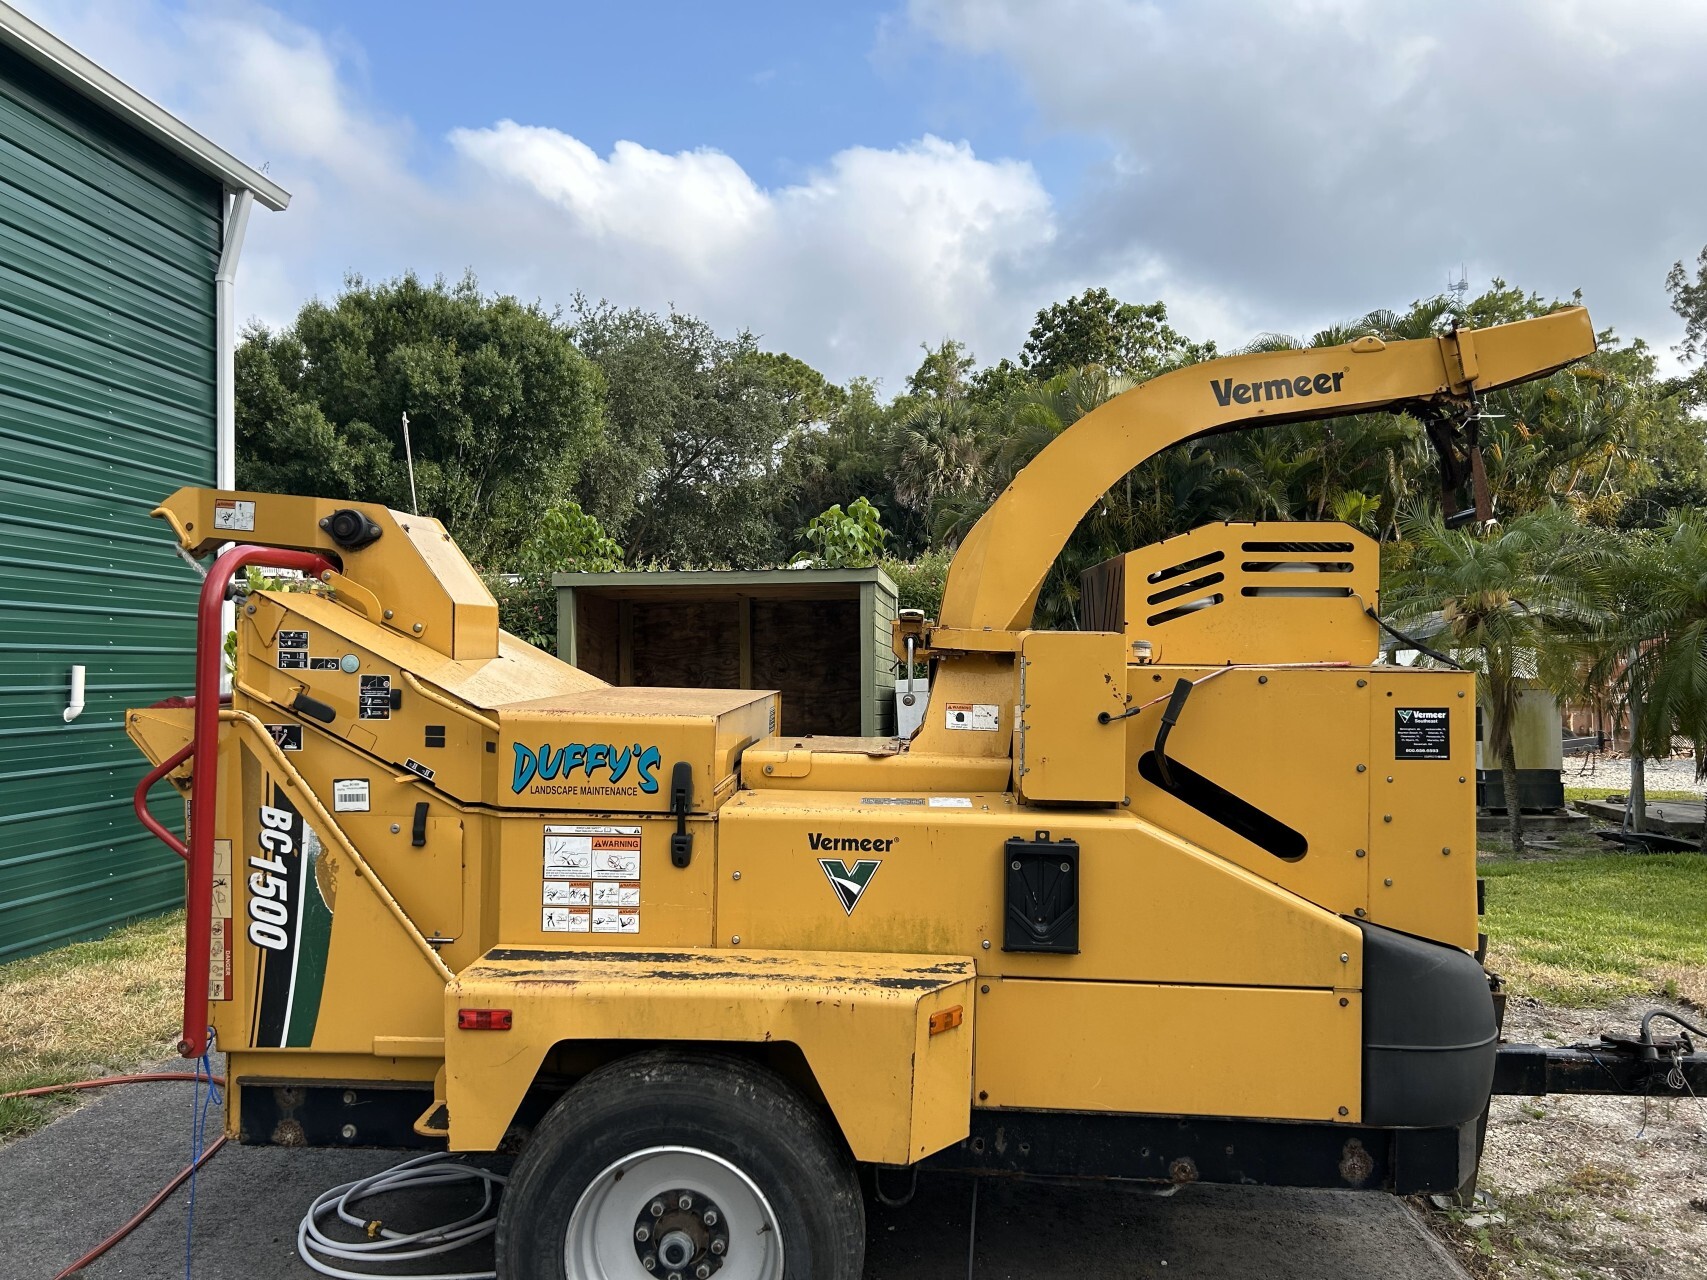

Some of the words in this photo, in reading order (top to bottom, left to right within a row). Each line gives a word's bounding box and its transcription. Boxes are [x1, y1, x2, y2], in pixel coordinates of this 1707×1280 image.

[1413, 710, 1447, 718] Vermeer
[511, 741, 662, 795] DUFFY'S
[530, 785, 578, 796] LANDSCAPE
[579, 785, 638, 797] MAINTENANCE
[601, 839, 639, 848] WARNING
